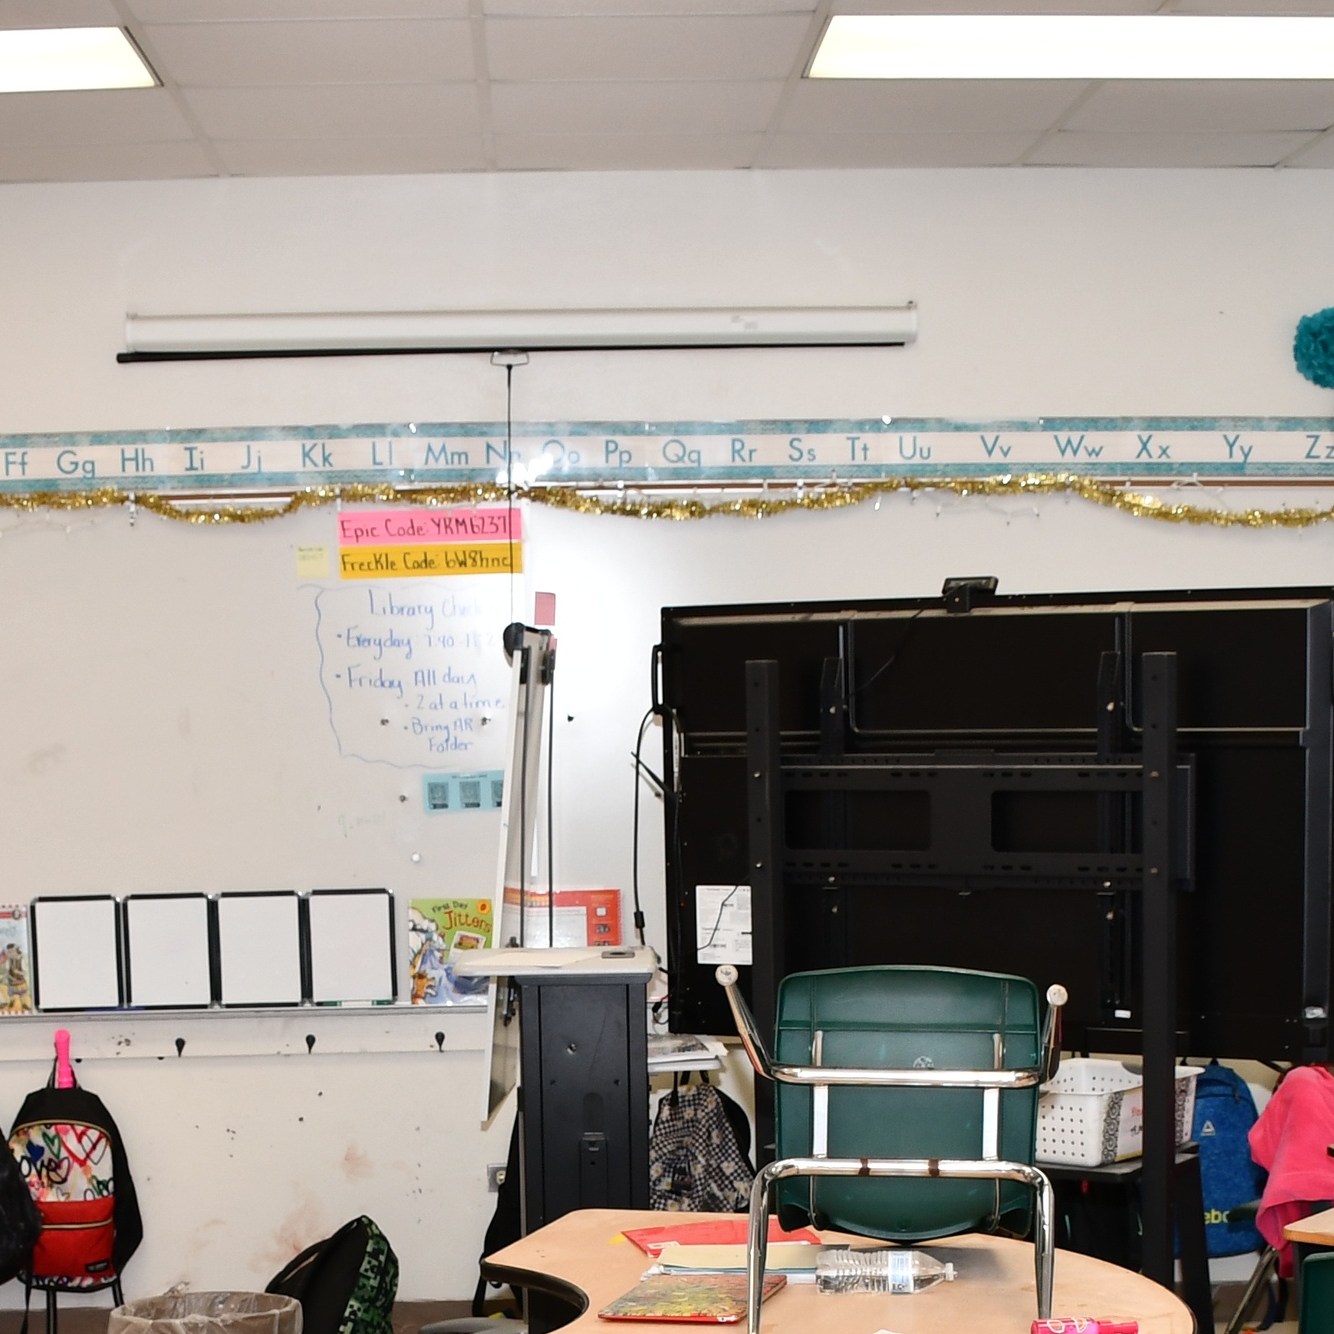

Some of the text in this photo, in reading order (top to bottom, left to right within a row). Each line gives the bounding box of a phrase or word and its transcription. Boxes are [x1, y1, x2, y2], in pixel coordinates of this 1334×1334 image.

[4, 451, 28, 477] Ff
[56, 451, 97, 479] Gg
[120, 447, 154, 473] Hh
[184, 446, 205, 471] Ii
[241, 444, 263, 474] Jj
[301, 442, 334, 468] Kk
[371, 441, 394, 467] Ll
[425, 441, 469, 467] Mm
[604, 440, 632, 468] Pp
[662, 438, 702, 467] Qq
[731, 438, 758, 463] Rr
[788, 437, 817, 463] Ss
[846, 436, 870, 461] Tt
[898, 436, 932, 461] Uu
[980, 434, 1013, 459] Vv
[1053, 434, 1105, 459] Ww
[1135, 434, 1171, 460] Xx
[1222, 434, 1254, 465] Yy
[340, 519, 379, 544] Epic
[368, 589, 435, 630] Library
[346, 625, 413, 661] Everyday
[348, 664, 478, 699] Friday All day
[411, 717, 474, 742] Bring AR
[428, 736, 475, 753] Folder
[431, 901, 469, 914] First Day
[443, 909, 493, 934] Jitters
